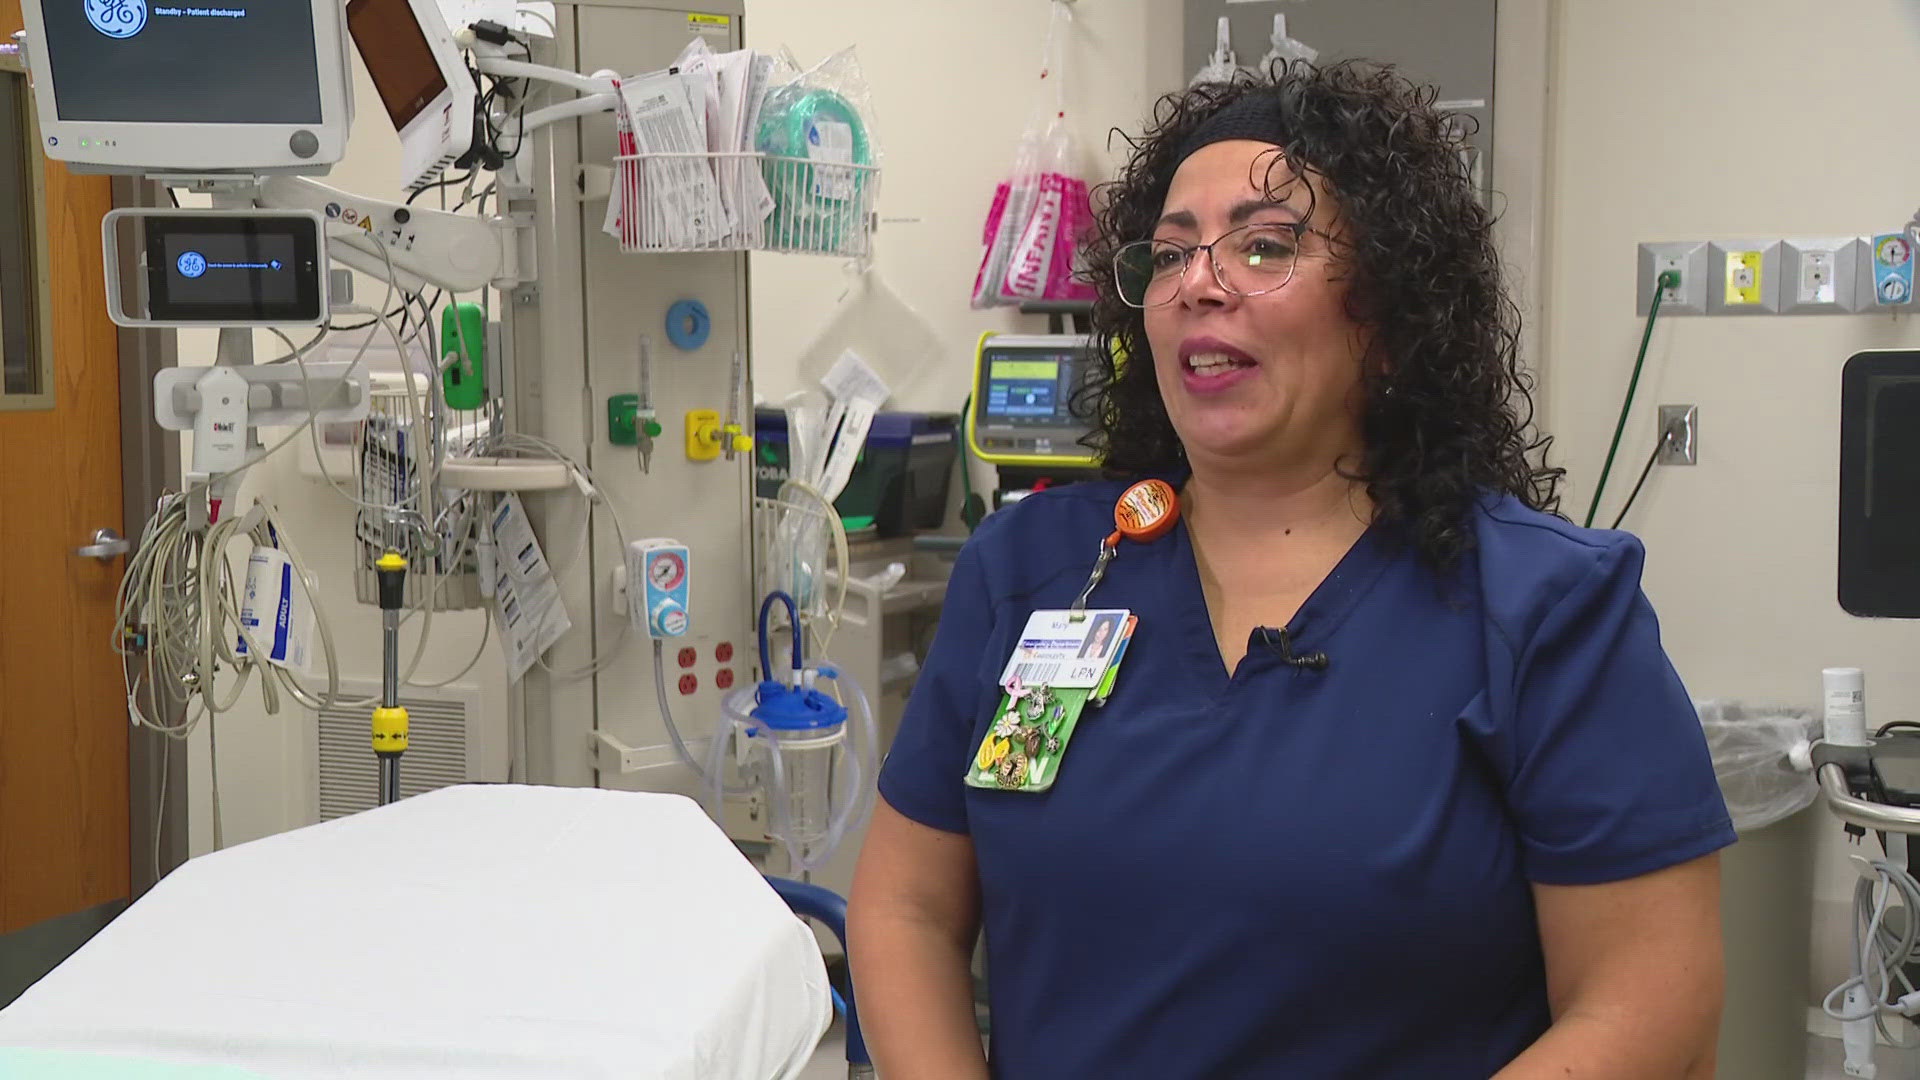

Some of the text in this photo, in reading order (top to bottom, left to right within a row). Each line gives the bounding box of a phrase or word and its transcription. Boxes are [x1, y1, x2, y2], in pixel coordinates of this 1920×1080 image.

[154, 7, 182, 17] Standby
[187, 8, 210, 16] Patient
[210, 8, 246, 18] discharged
[279, 597, 289, 628] ADULT
[1070, 667, 1097, 679] LPN
